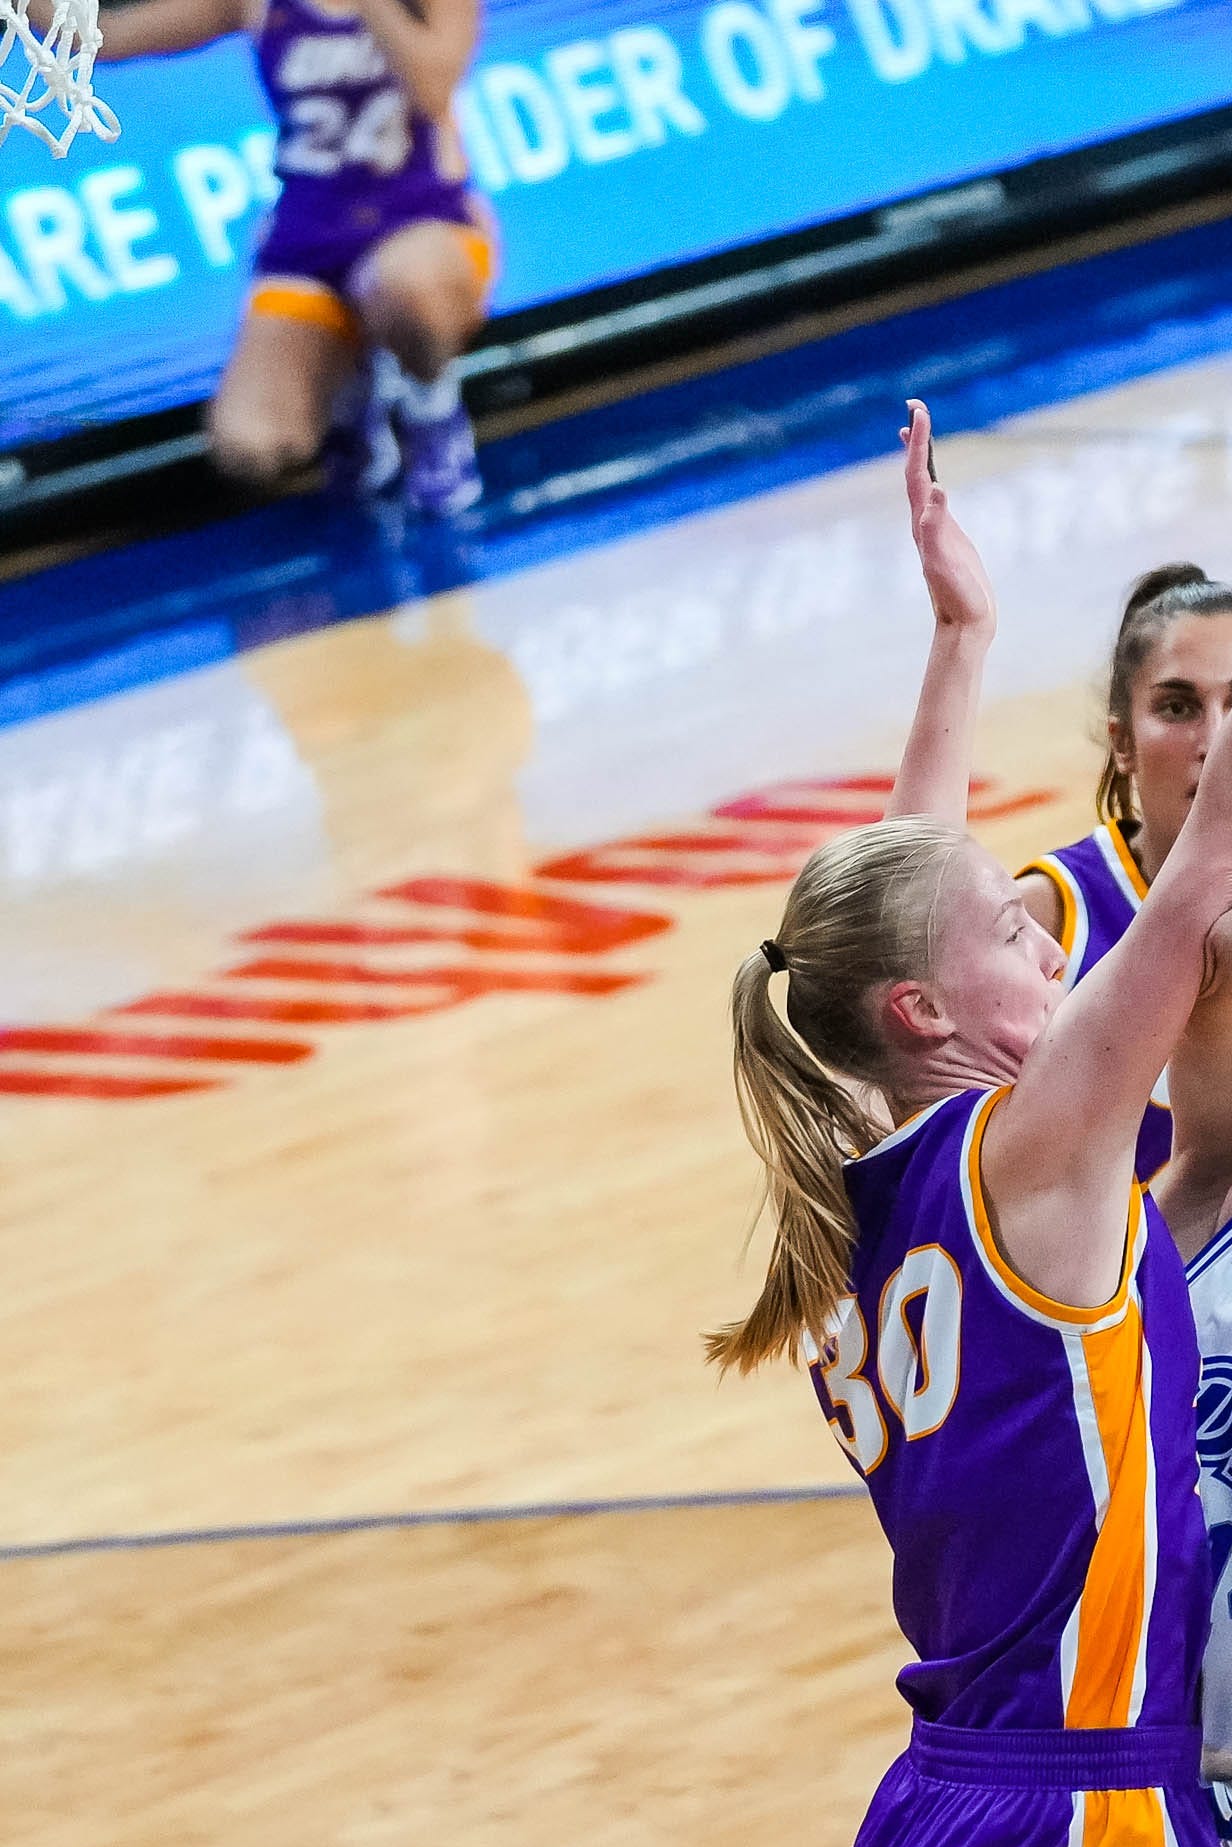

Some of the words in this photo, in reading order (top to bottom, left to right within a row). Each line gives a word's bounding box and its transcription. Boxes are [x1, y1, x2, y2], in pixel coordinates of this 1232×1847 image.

[174, 24, 706, 268] PIDER
[702, 0, 836, 122] OF
[280, 92, 412, 172] 24
[801, 1239, 963, 1476] 30
